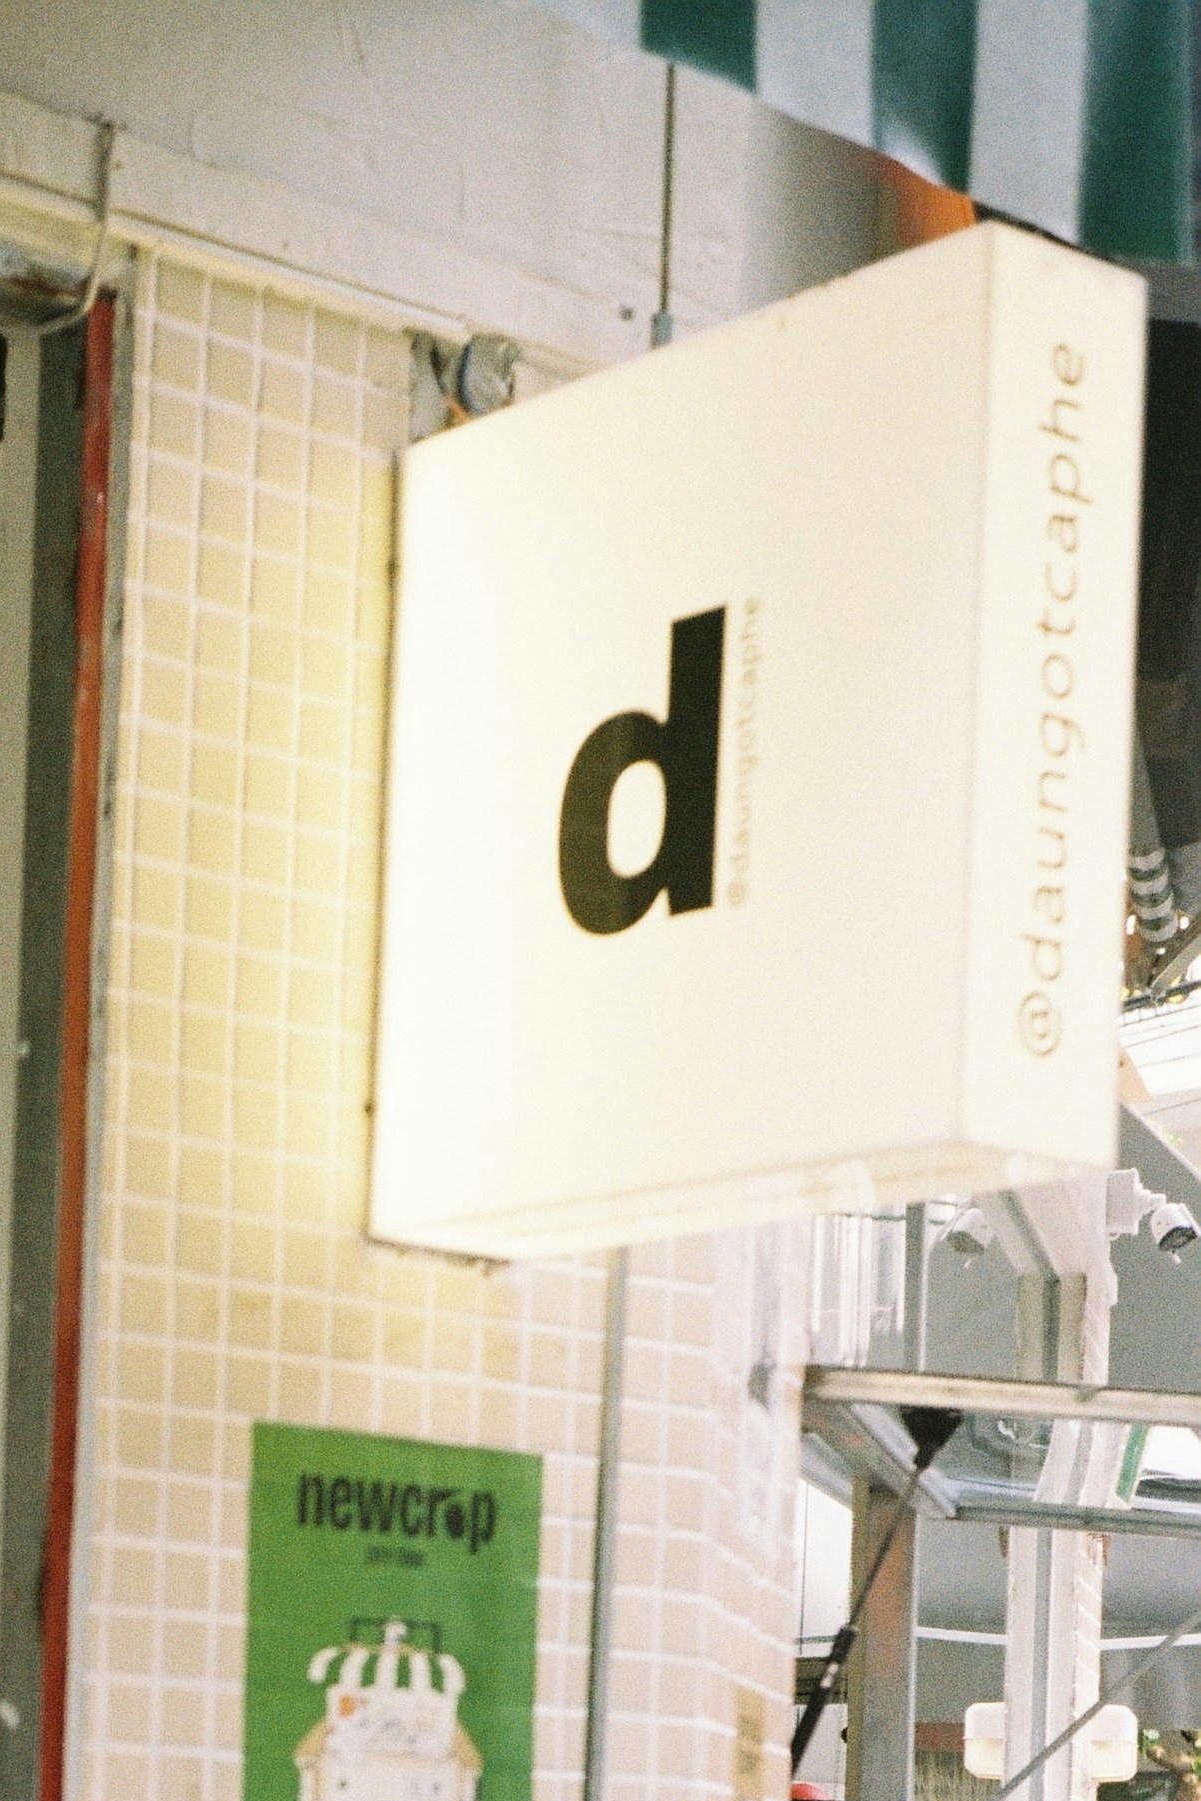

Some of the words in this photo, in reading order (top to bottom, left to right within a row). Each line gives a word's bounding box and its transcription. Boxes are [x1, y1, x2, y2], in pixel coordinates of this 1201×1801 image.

[557, 604, 727, 936] d
[1018, 341, 1092, 1058] @daungotcaphe
[299, 1472, 497, 1553] newcrop
